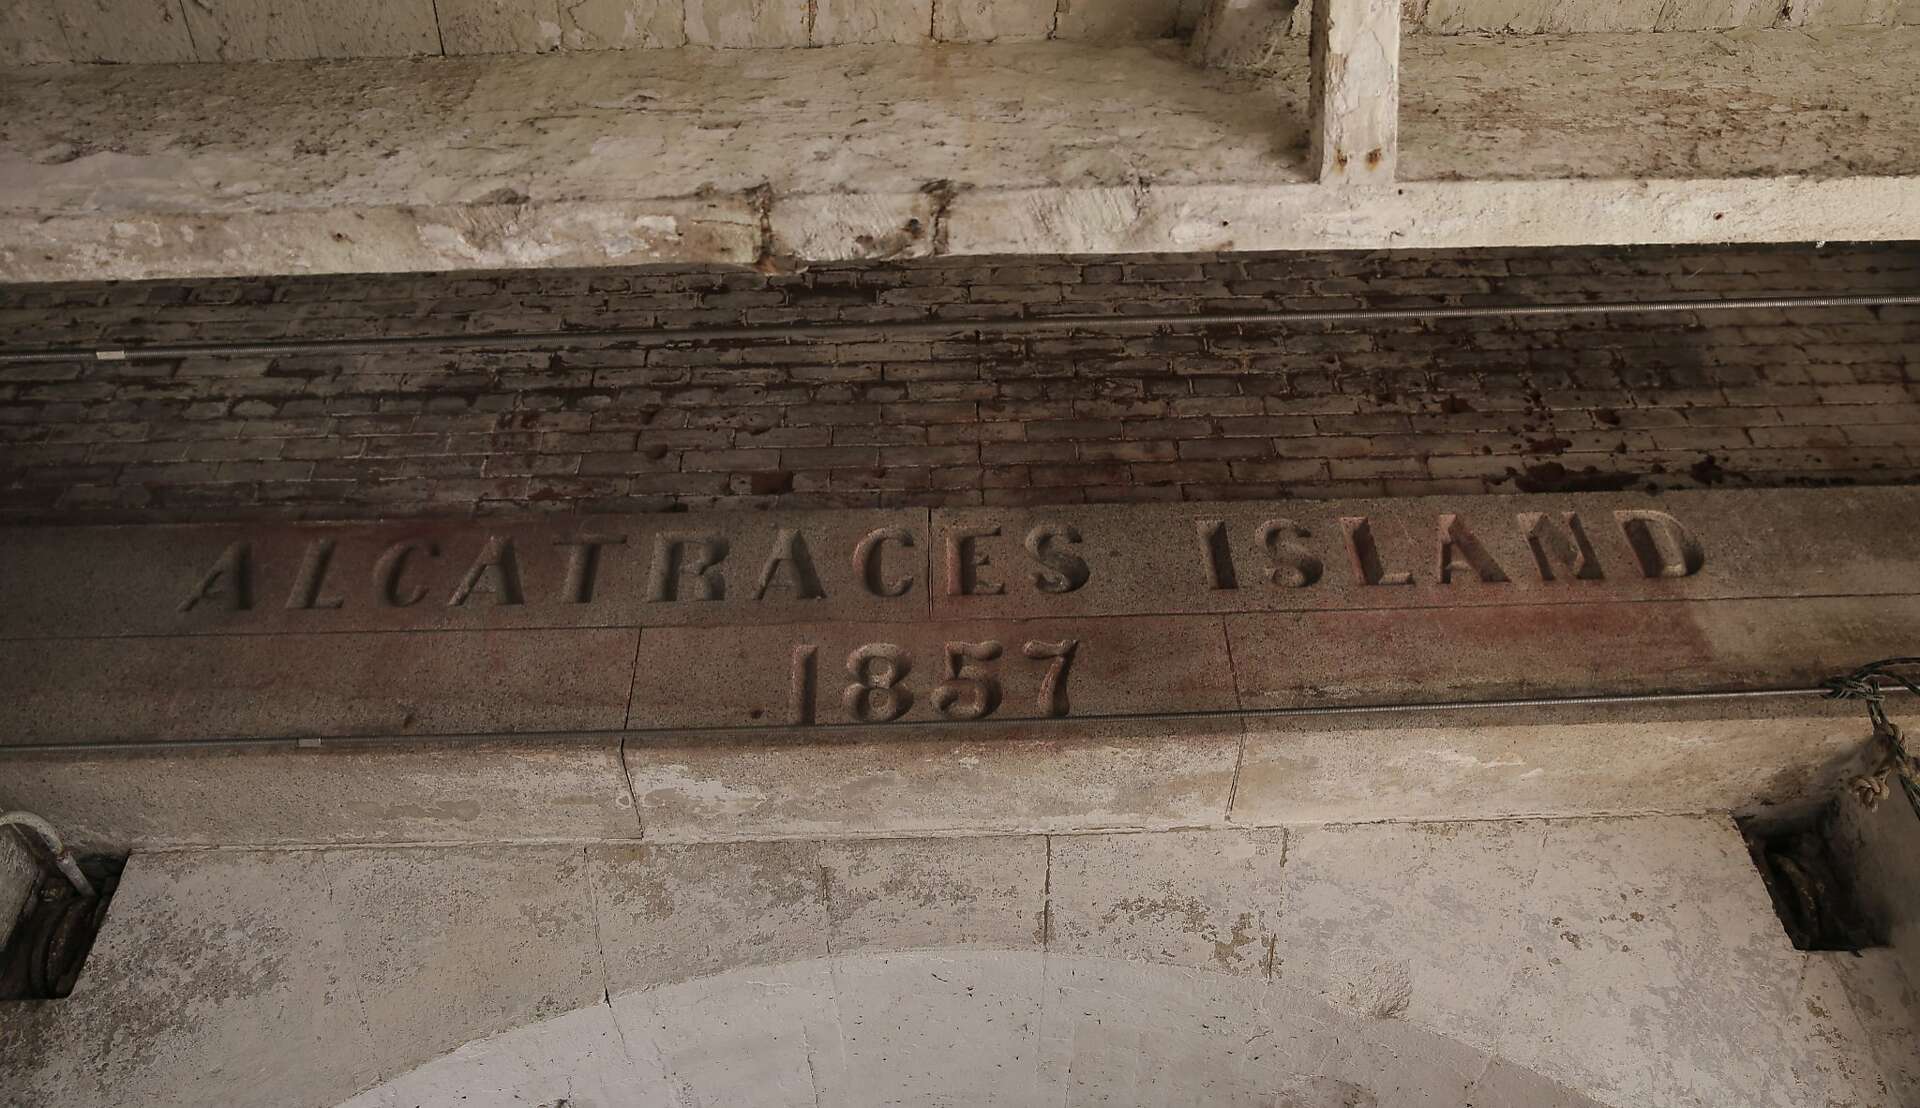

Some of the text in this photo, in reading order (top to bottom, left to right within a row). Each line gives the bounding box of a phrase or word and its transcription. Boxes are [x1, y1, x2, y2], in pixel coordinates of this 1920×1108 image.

[176, 508, 1705, 612] ALCATRACES ISLAND
[790, 638, 1080, 725] 1857
